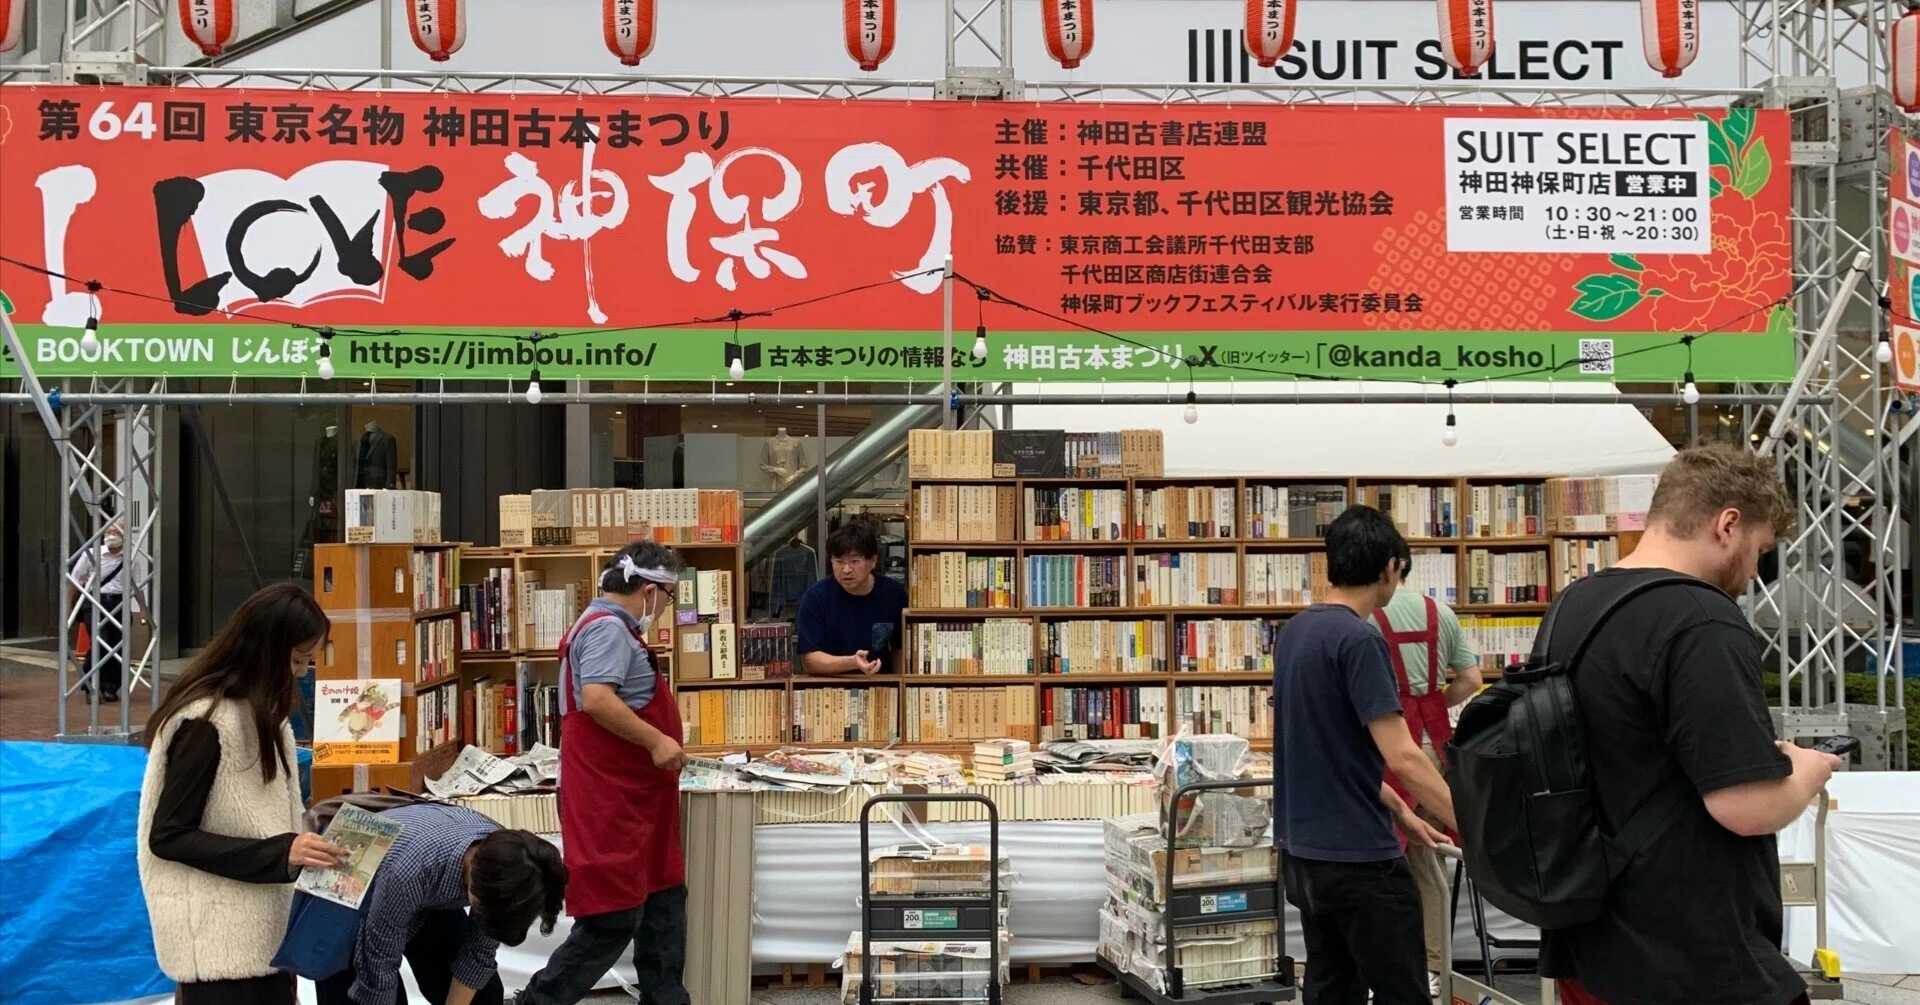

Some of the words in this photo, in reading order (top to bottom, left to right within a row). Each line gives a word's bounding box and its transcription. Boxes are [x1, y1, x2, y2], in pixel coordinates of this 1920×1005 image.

[419, 0, 432, 35] まつり
[1274, 39, 1398, 80] SUIT
[1414, 39, 1623, 81] SLECT
[37, 99, 206, 143] 第64回
[225, 103, 405, 147] 東京名物
[423, 105, 731, 150] 神田古本まつり
[1457, 130, 1543, 164] SUIT
[1556, 132, 1696, 165] SELECT
[1459, 171, 1611, 196] 神田神保町店
[1625, 174, 1687, 195] 営業中
[153, 165, 456, 317] LOVE
[477, 122, 972, 325] 神保町
[1459, 205, 1524, 221] 営業時間
[1060, 264, 1274, 285] 千代田区商店街連合会
[1060, 293, 1424, 314] 神保町ブックフェスティバル実行委員会
[37, 337, 213, 363] BOOKTOWN
[350, 339, 658, 370] https://jimbou.info/
[1003, 344, 1182, 370] 神田古本まつり
